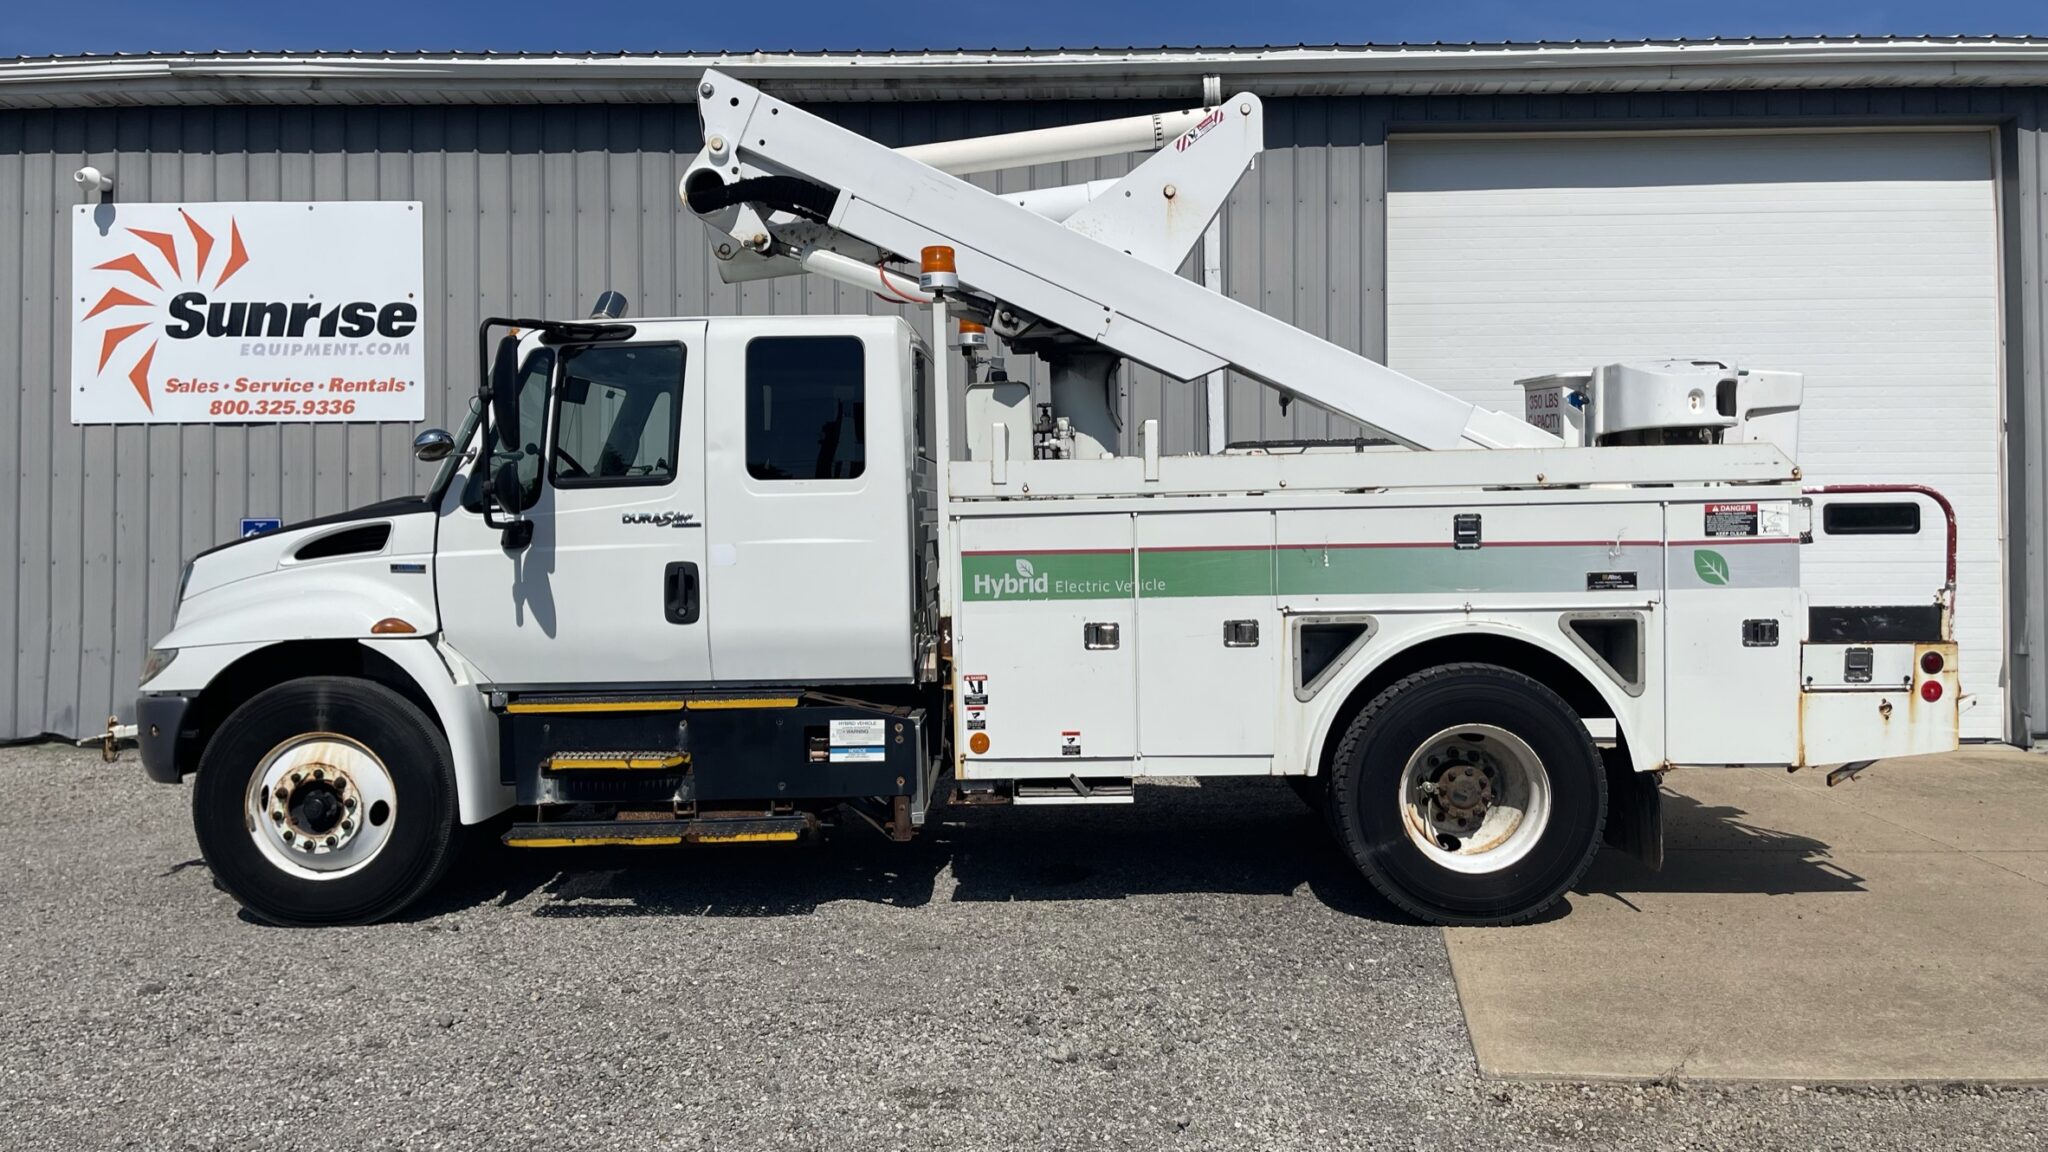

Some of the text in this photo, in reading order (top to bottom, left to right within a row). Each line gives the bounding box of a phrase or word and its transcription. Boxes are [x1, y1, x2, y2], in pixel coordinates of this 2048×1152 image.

[165, 291, 417, 340] Sunrise
[240, 342, 411, 357] EQUIPMENT.COM
[165, 377, 406, 393] Sales Service Rentals
[209, 399, 356, 415] 800.325.9336
[1529, 392, 1559, 410] 350 LBS
[1720, 504, 1751, 512] DANGER
[974, 572, 1048, 598] Hybrid
[1055, 580, 1110, 593] Electric
